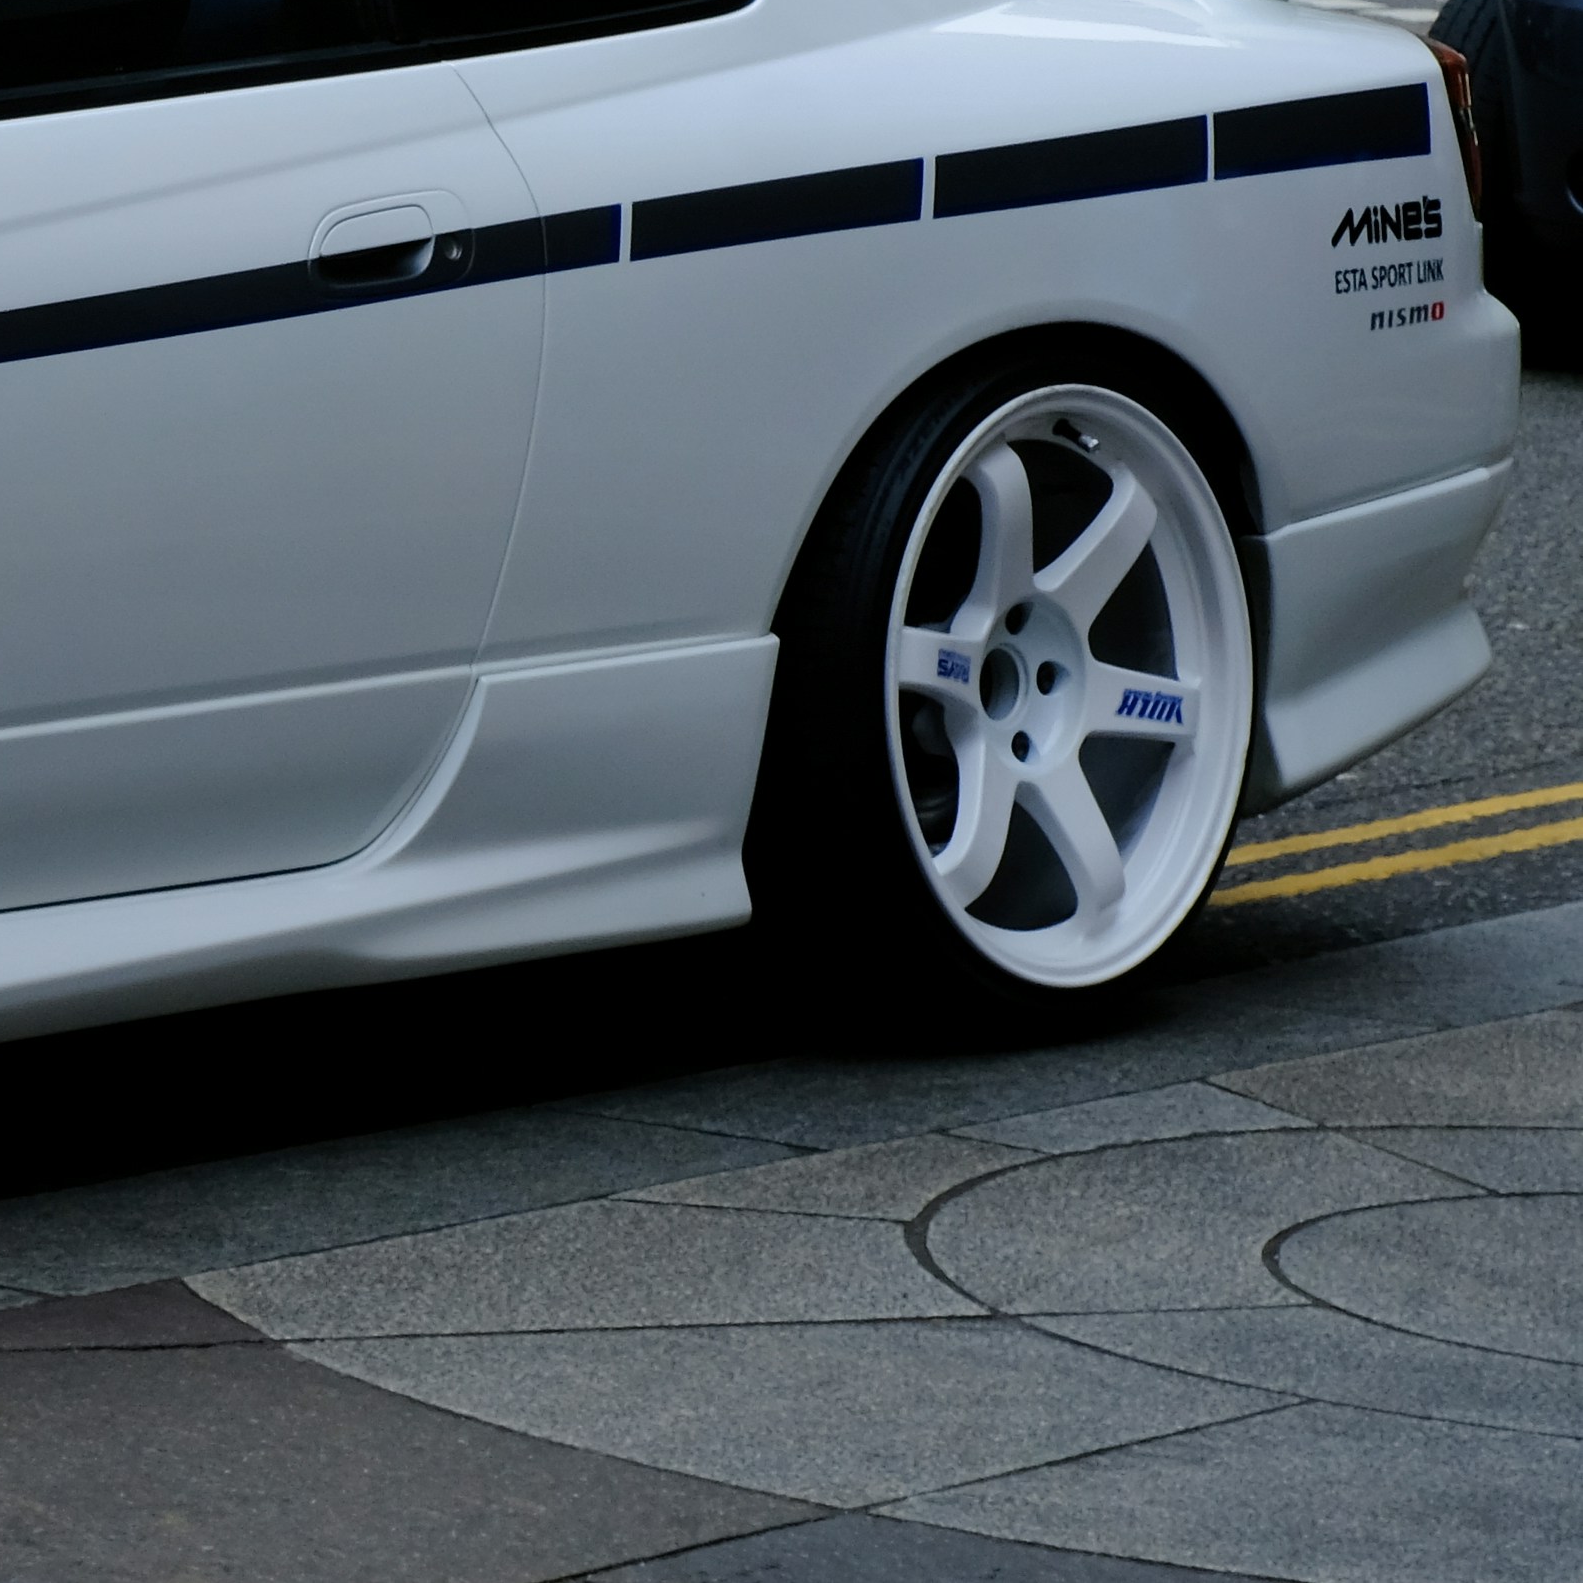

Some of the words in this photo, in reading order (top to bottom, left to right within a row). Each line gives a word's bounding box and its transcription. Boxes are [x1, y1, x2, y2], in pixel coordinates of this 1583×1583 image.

[1335, 268, 1368, 294] ESTA
[1371, 261, 1413, 290] SPORT
[1417, 257, 1444, 284] LINK
[1370, 301, 1444, 330] nismo
